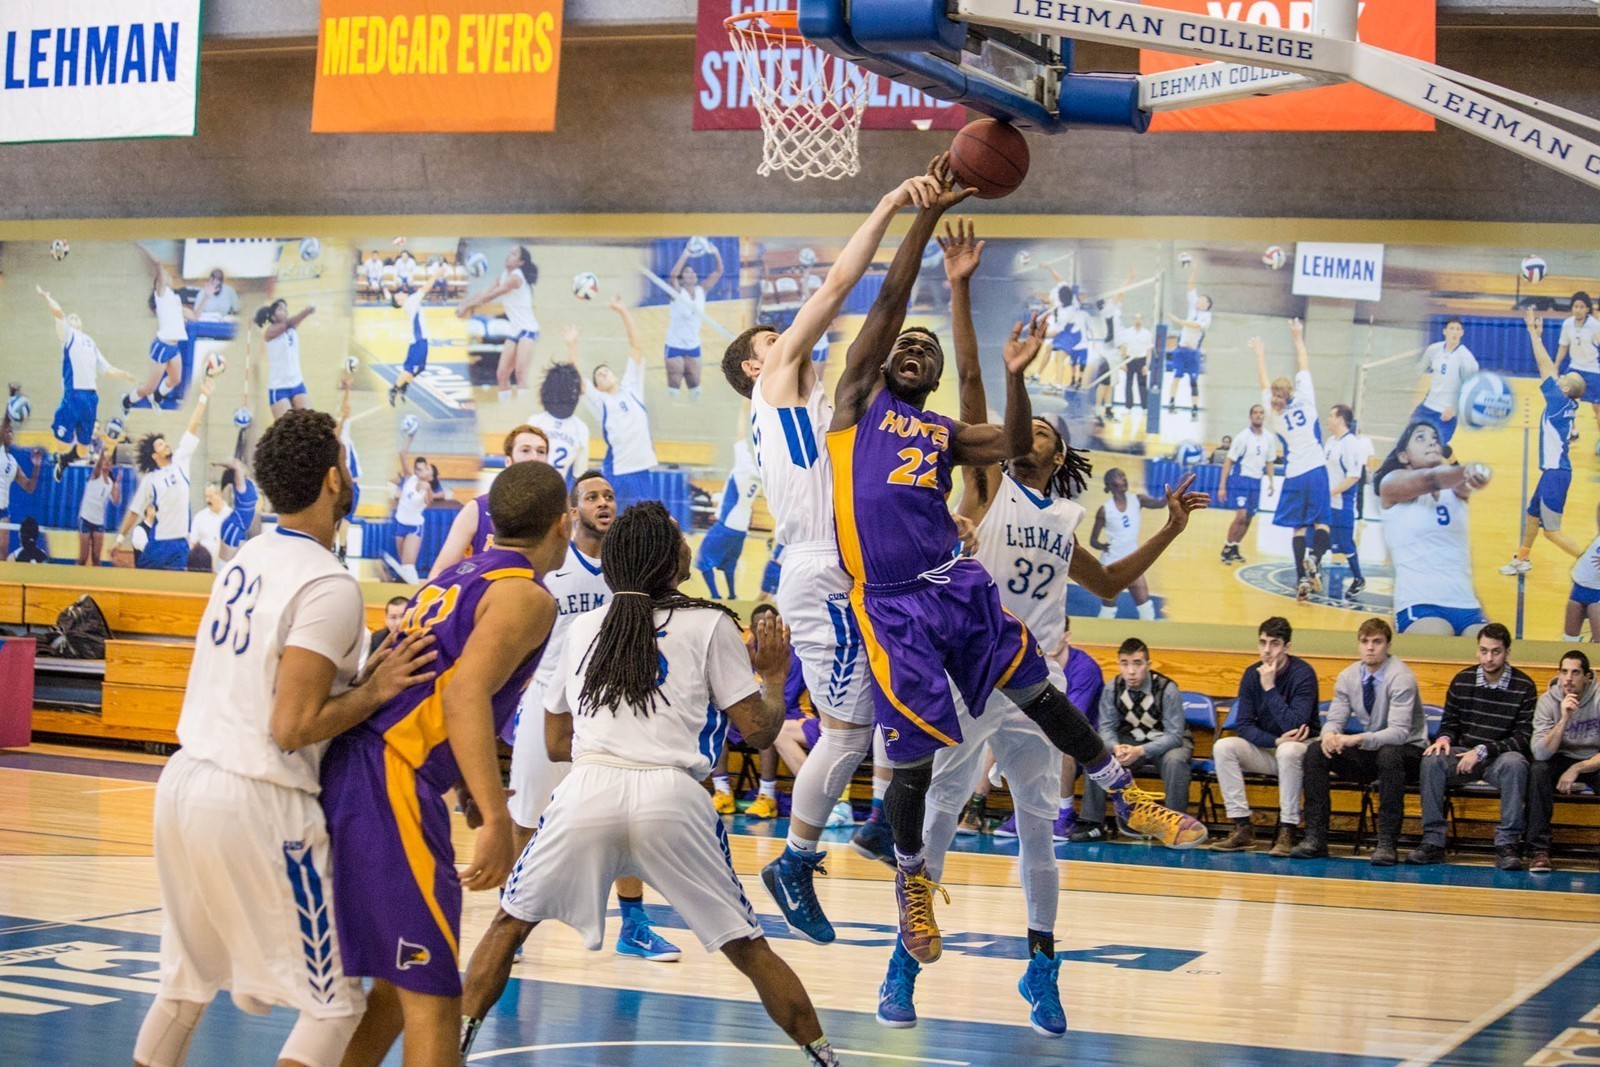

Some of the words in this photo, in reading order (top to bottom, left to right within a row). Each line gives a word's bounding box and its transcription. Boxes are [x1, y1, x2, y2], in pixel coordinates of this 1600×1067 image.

[322, 16, 451, 77] MEDGAR
[456, 11, 555, 74] EVERS
[1014, 0, 1164, 36] LEHMAN
[1180, 23, 1314, 60] COLLEGE
[4, 22, 180, 90] LEHMAN
[701, 49, 825, 110] STATEN
[831, 50, 954, 108] ISLA
[1151, 71, 1223, 98] LEHMAN
[1423, 83, 1573, 160] LEHMAN
[1302, 254, 1375, 282] LEHMAN
[1283, 409, 1306, 431] 13
[554, 447, 568, 469] 2
[886, 447, 939, 489] 22
[1436, 505, 1451, 526] 9
[1007, 557, 1055, 600] 32
[211, 565, 262, 655] 33
